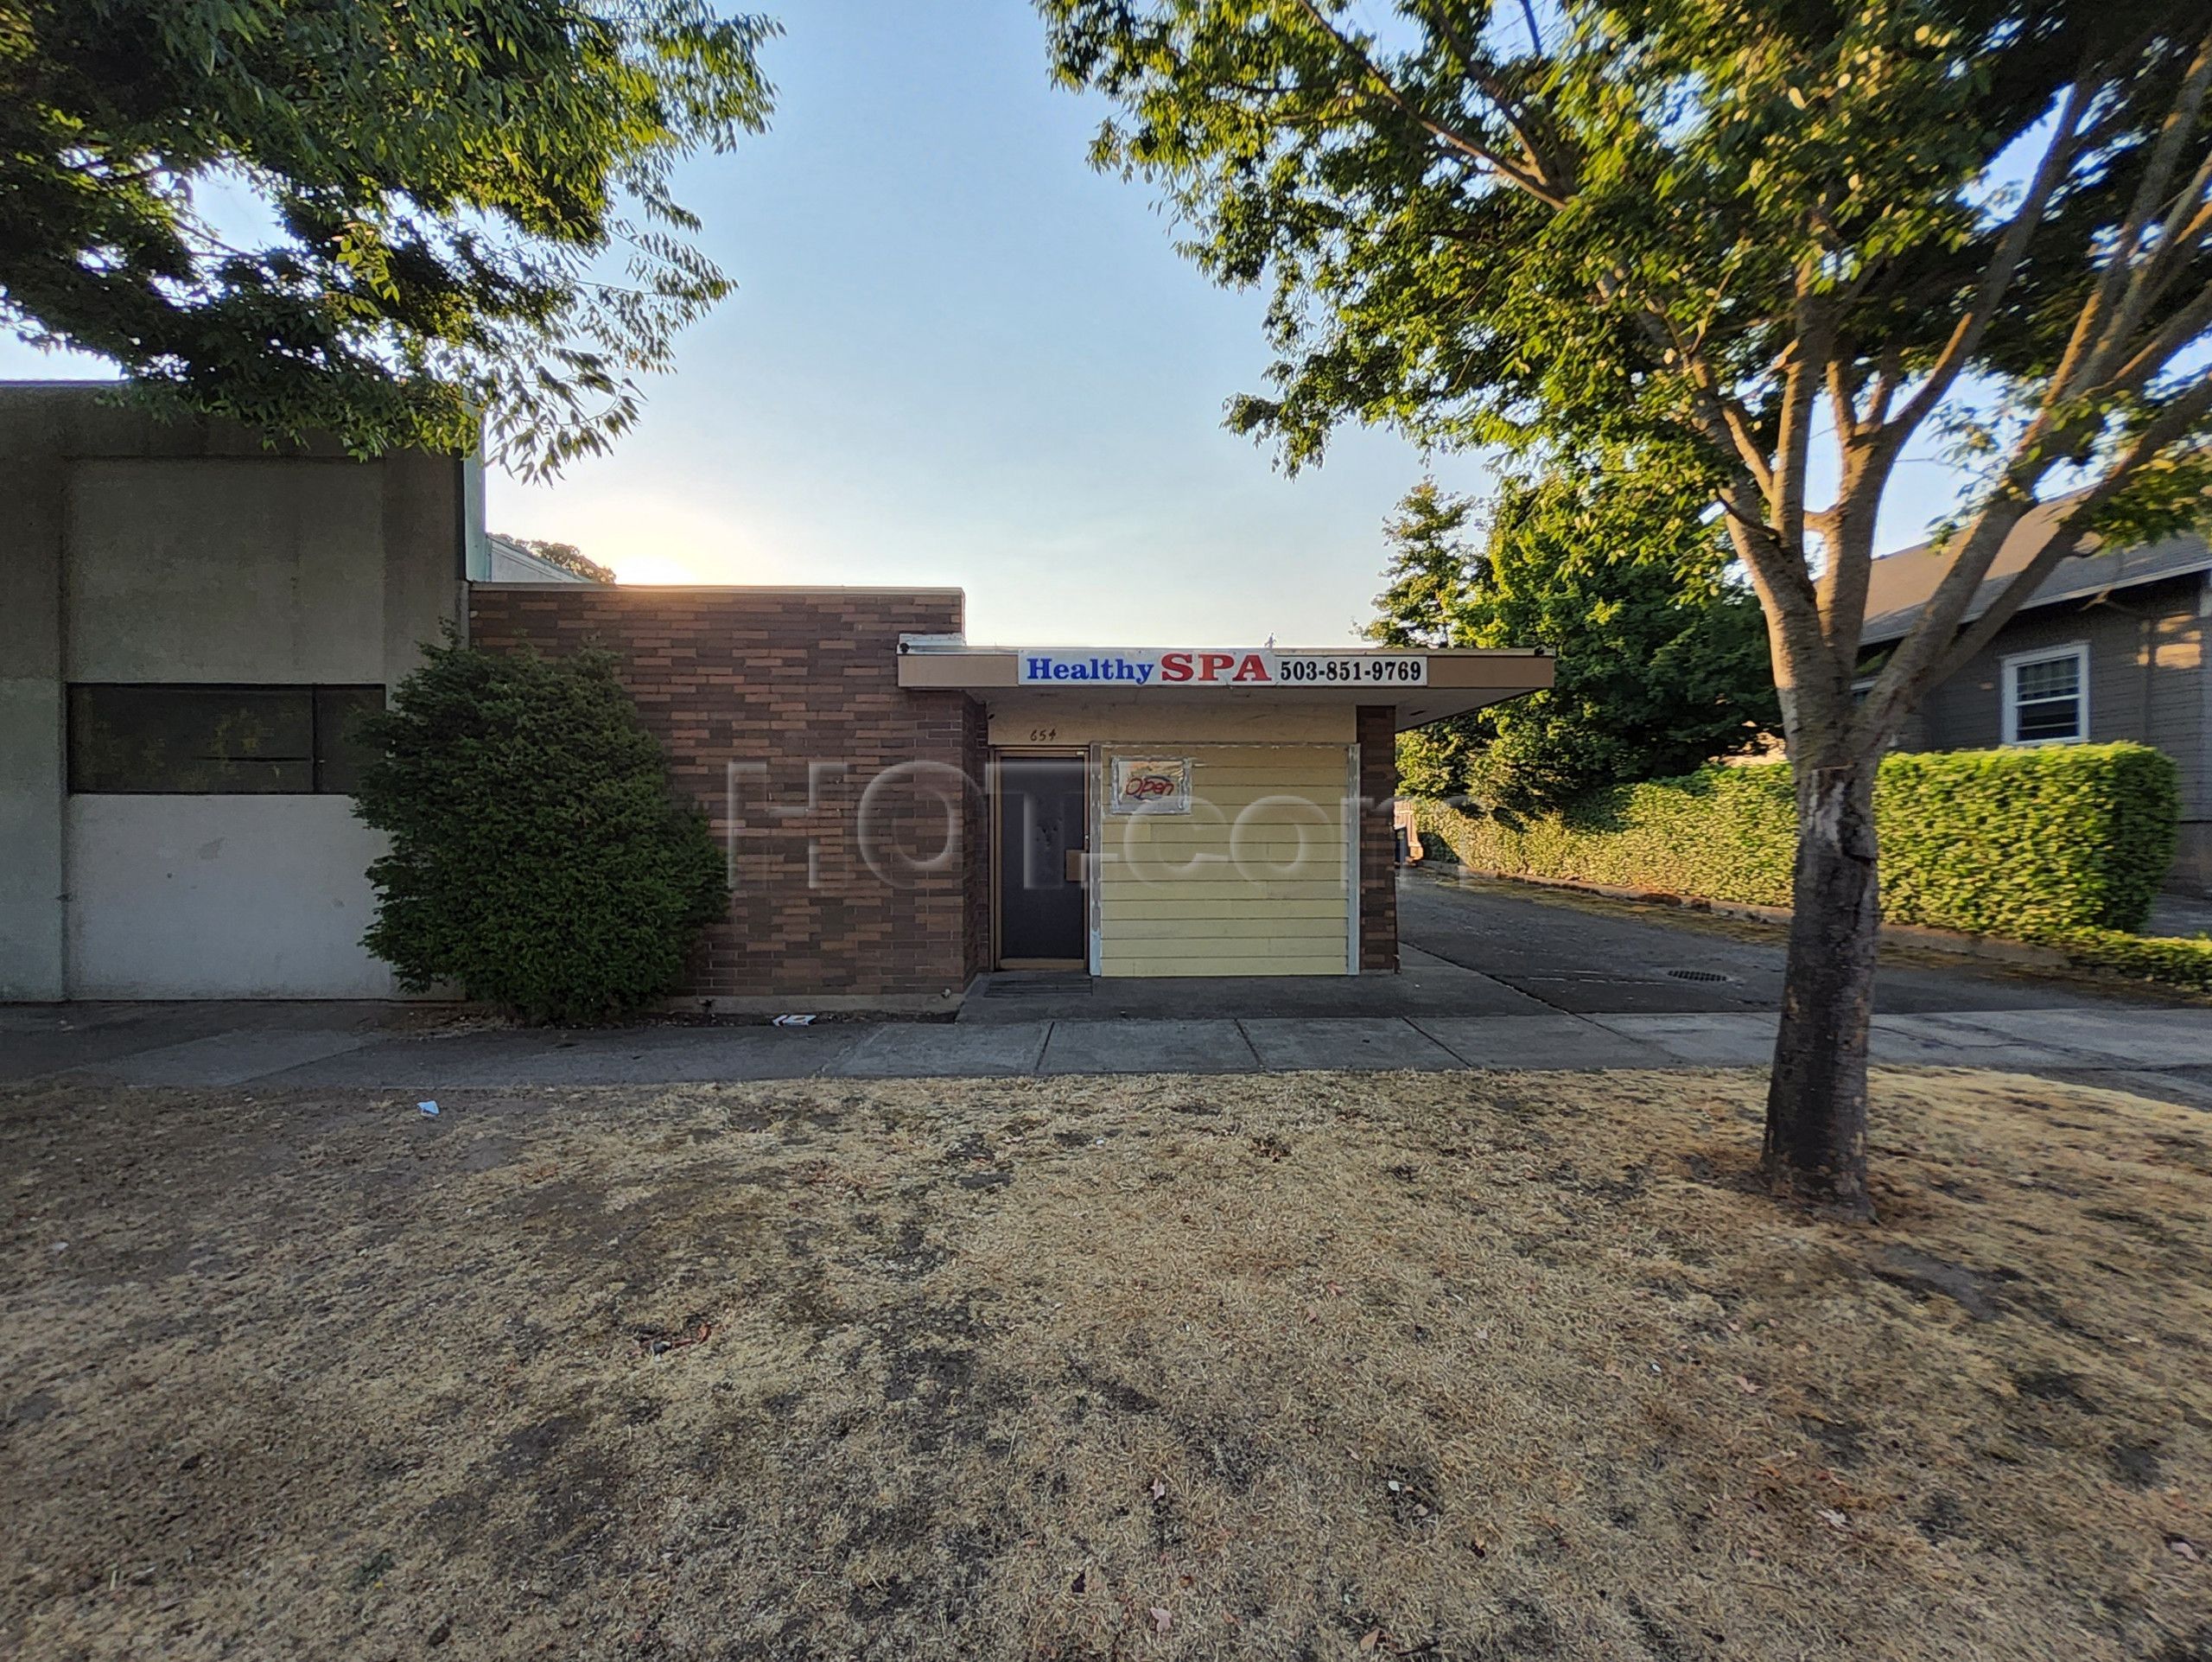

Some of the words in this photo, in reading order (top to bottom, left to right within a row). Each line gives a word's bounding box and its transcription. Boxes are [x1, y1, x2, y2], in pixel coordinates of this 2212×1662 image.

[1027, 658, 1154, 685] Healthy
[1160, 653, 1272, 682] SPA
[1281, 660, 1421, 681] 503-851-9769
[1030, 728, 1057, 742] 654
